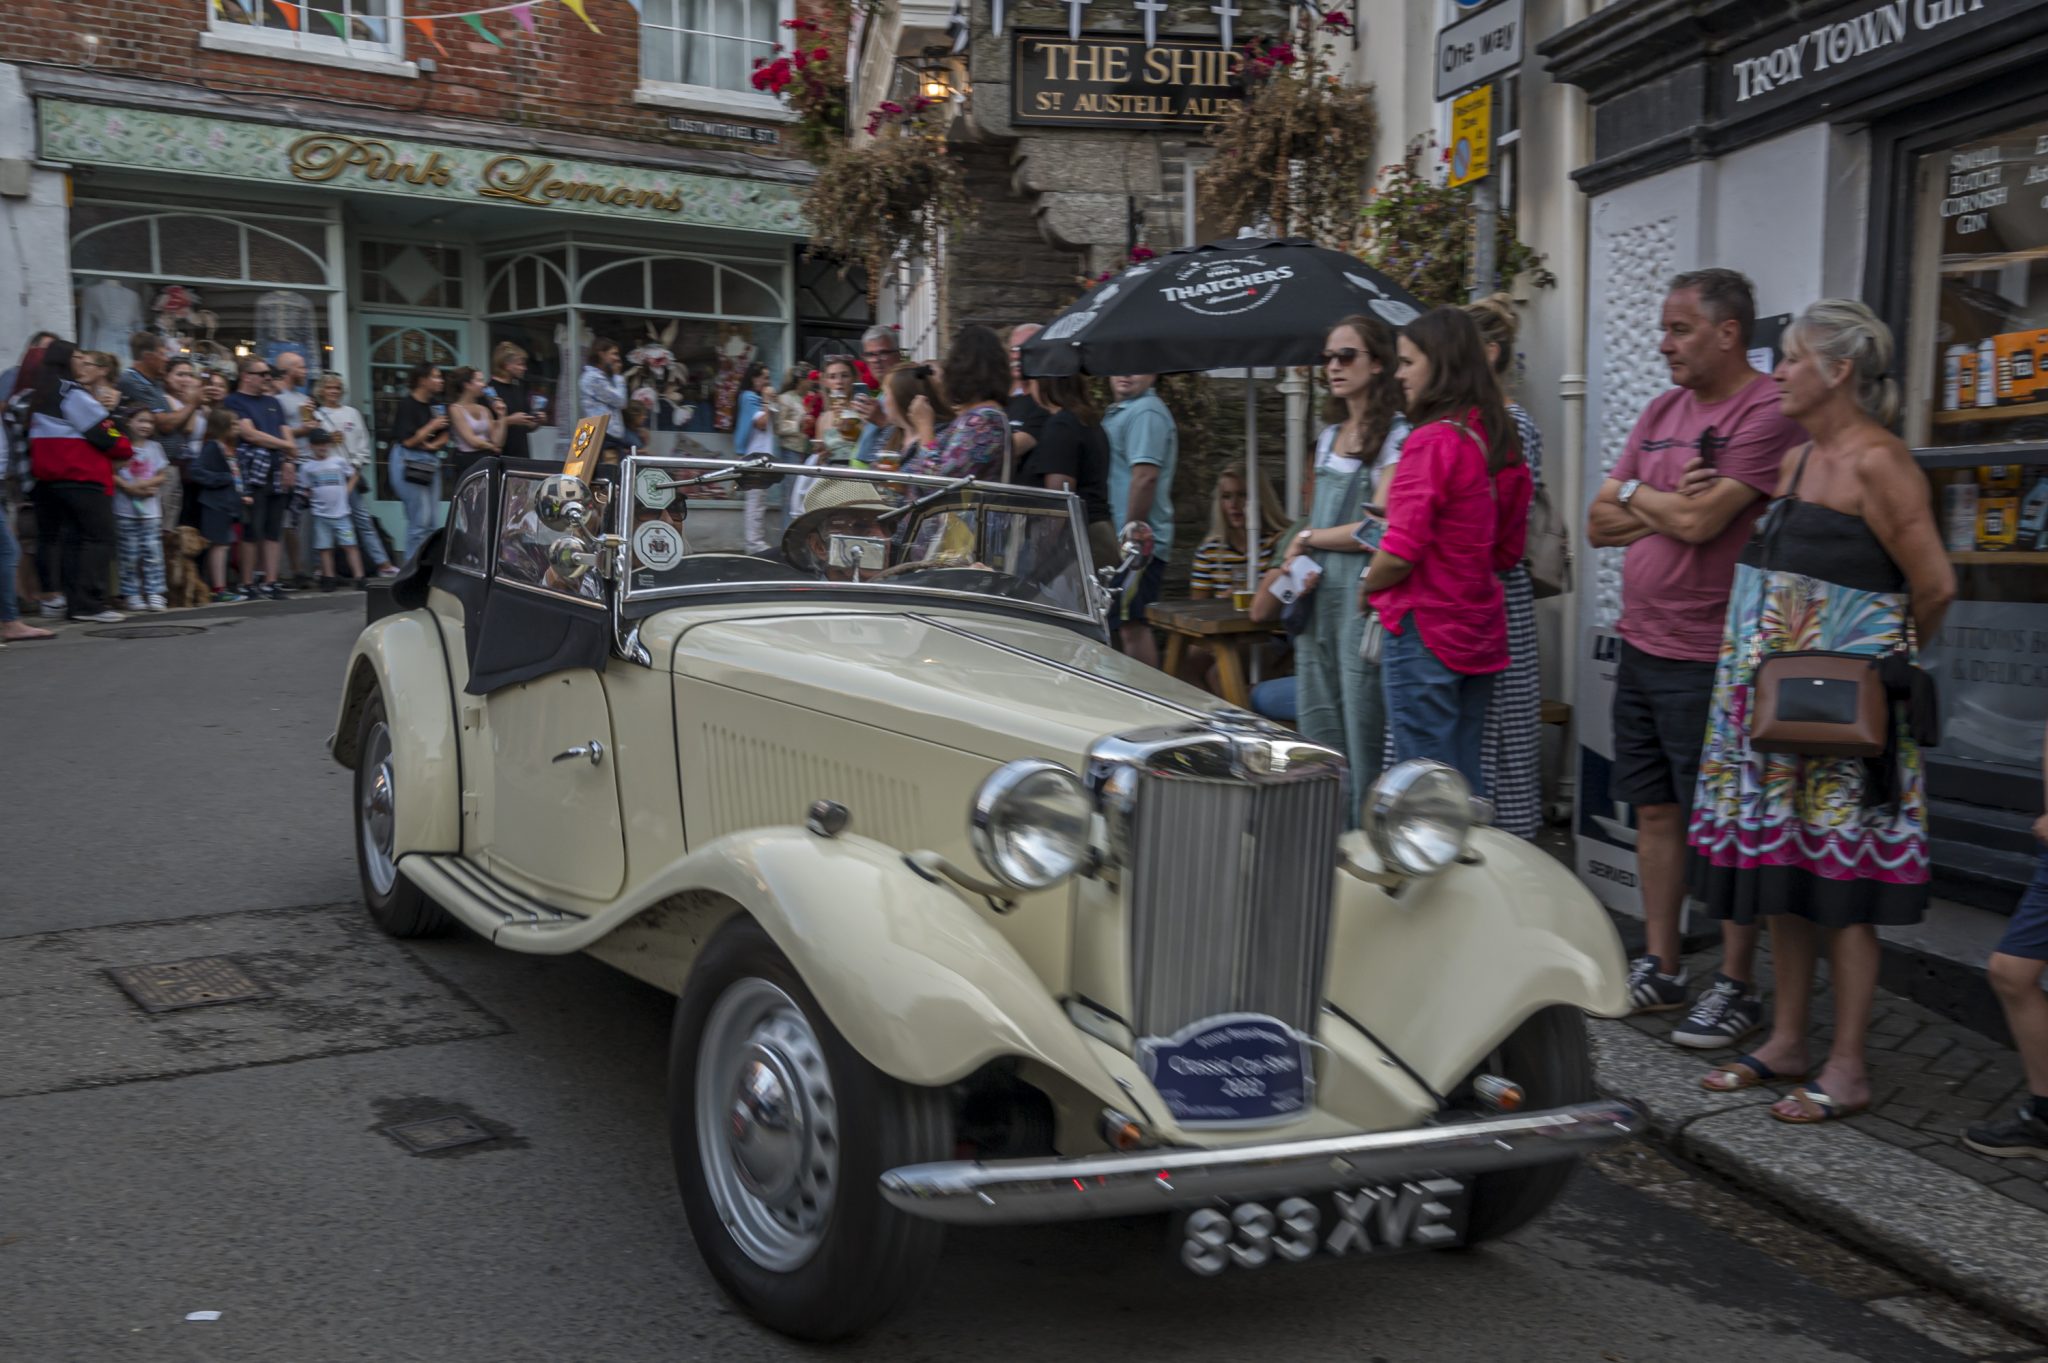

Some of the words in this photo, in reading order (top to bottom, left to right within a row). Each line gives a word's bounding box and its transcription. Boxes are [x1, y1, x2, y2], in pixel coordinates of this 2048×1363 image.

[1034, 43, 1131, 83] THE
[1142, 47, 1245, 87] SHIP
[1443, 43, 1475, 73] One
[1479, 22, 1516, 55] way
[1733, 34, 1809, 101] TROY
[1810, 1, 1907, 71] TOWN
[1073, 93, 1177, 115] AUSTELL
[288, 133, 452, 187] Pink
[478, 155, 686, 212] Lemons
[1956, 212, 1988, 234] GIN
[1159, 265, 1295, 302] THATCHERS
[1181, 1197, 1320, 1277] 833
[1326, 1177, 1464, 1257] XVE
